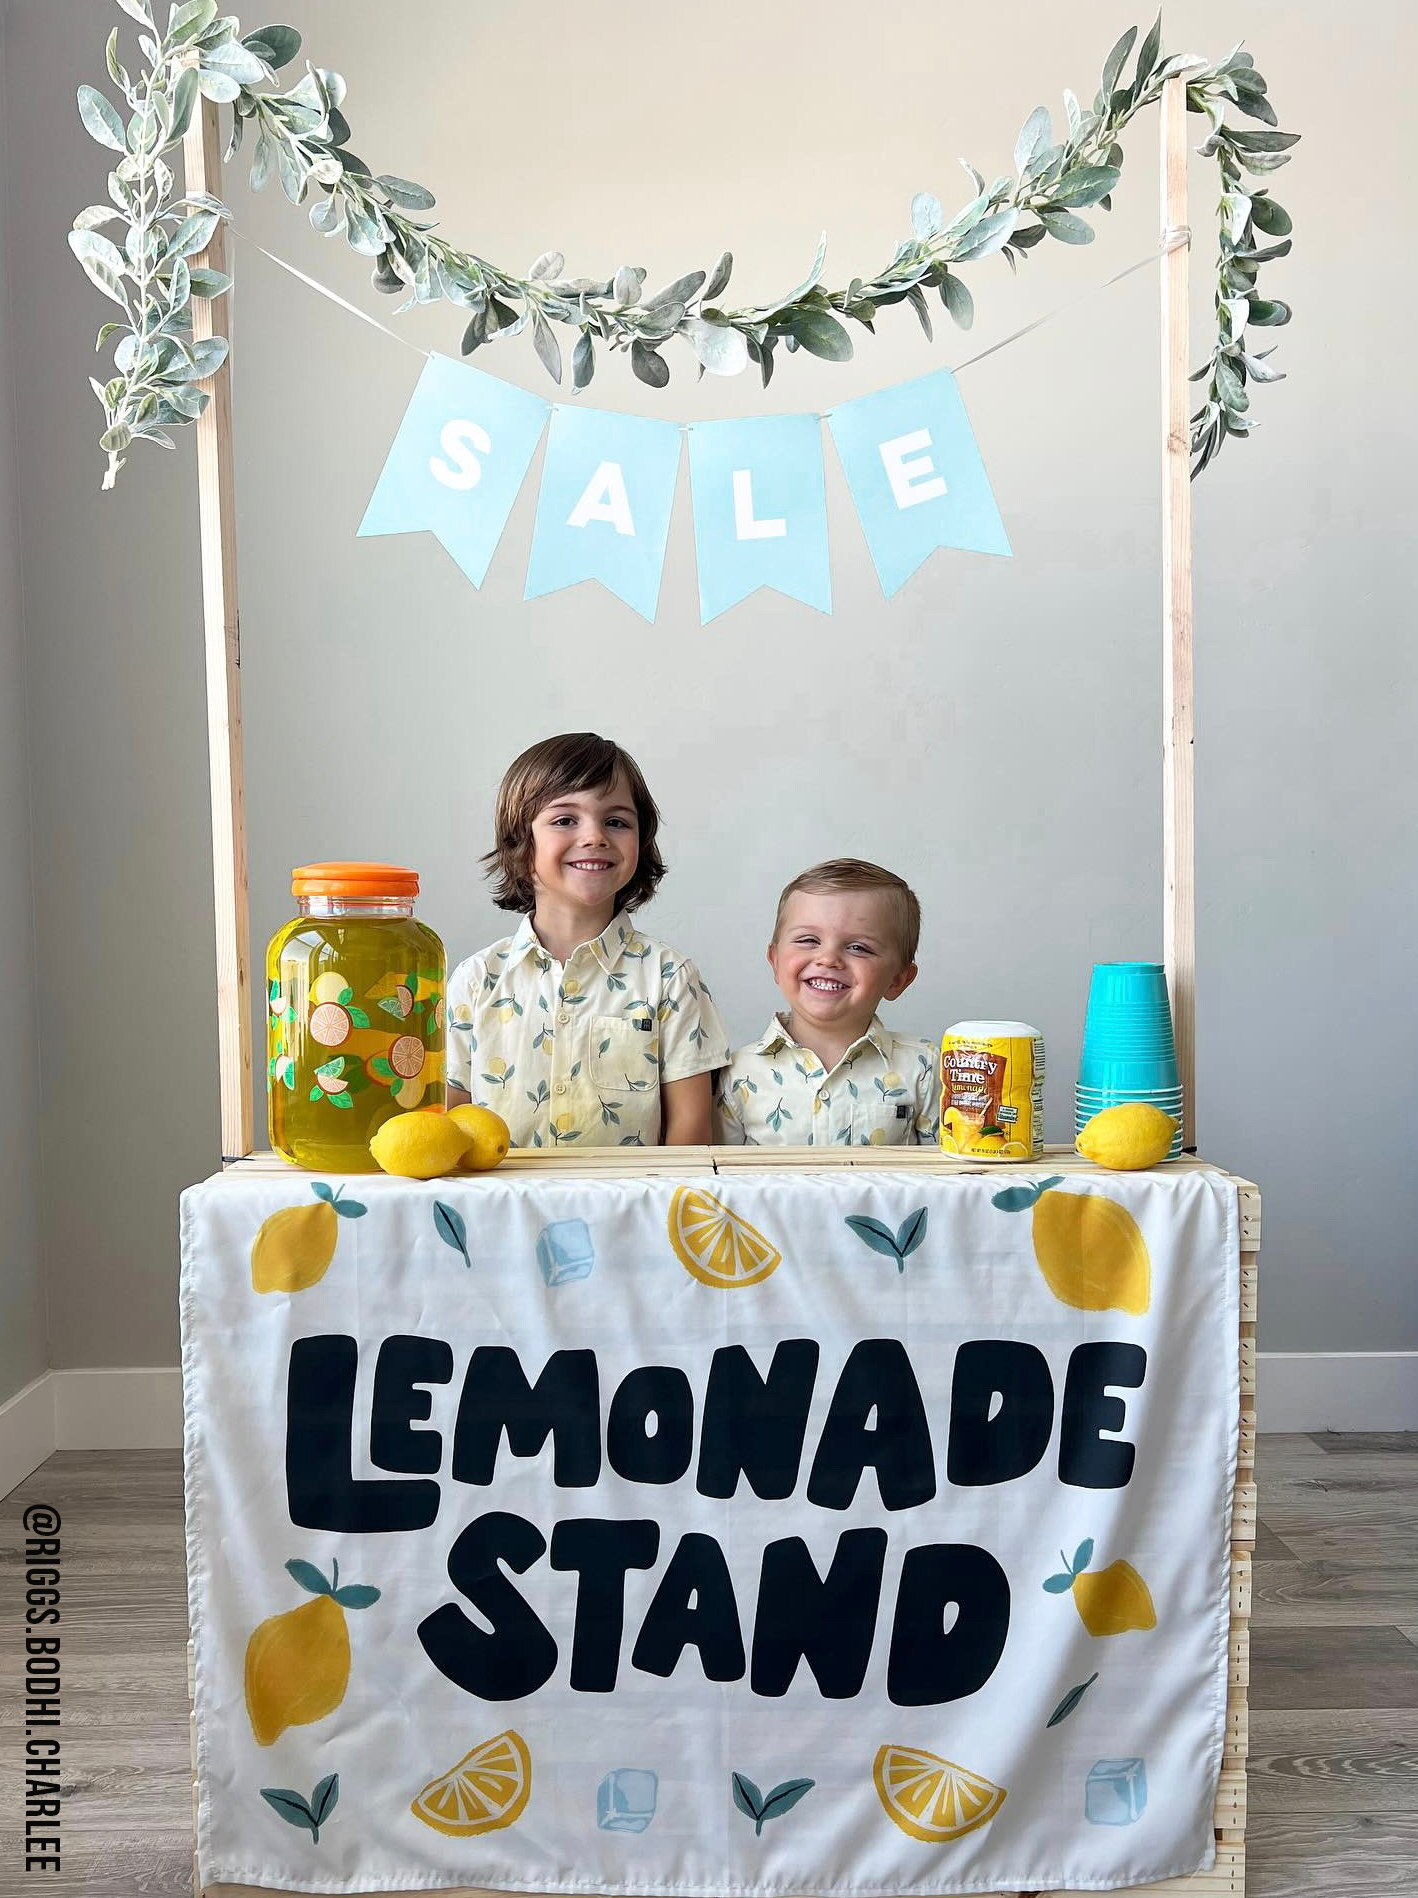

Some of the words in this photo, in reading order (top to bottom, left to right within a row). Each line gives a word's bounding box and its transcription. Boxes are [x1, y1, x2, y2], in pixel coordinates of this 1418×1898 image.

[429, 418, 948, 541] SALE
[943, 1055, 998, 1076] Country
[949, 1068, 986, 1084] Time
[286, 1334, 1148, 1534] LEMONADE
[416, 1511, 1011, 1707] STAND
